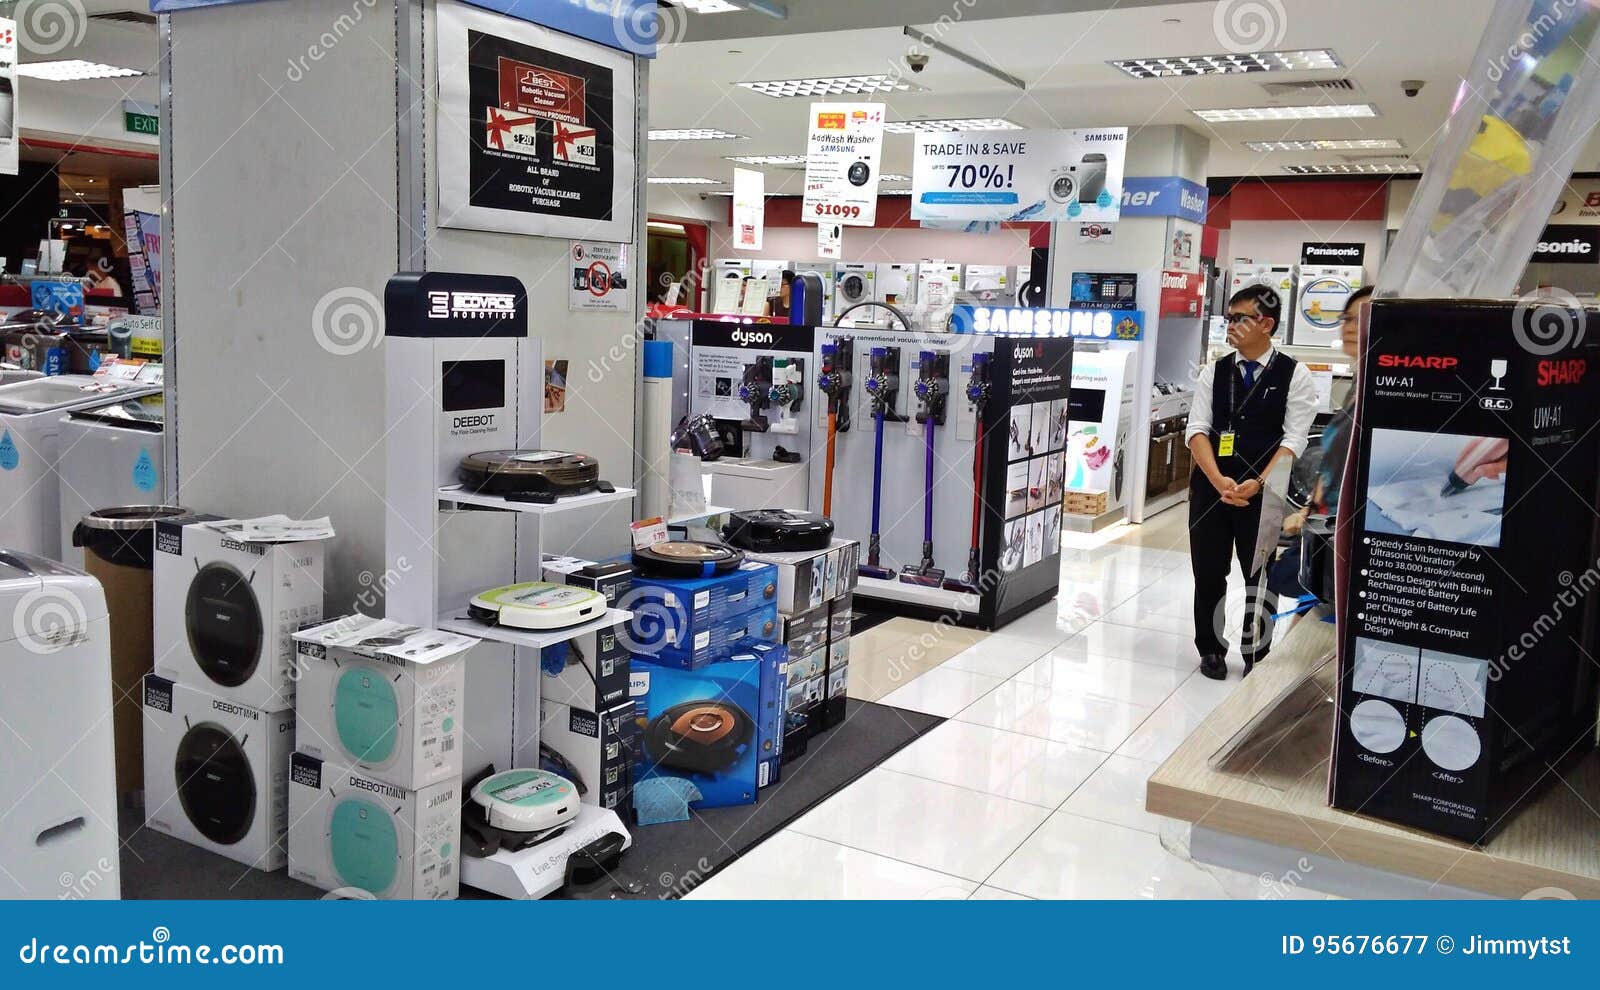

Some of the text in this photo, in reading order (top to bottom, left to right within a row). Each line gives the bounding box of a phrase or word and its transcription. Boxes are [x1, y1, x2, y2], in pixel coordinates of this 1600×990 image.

[532, 76, 554, 88] BEST
[521, 86, 566, 100] Robotic Vacuum
[533, 97, 555, 107] Cleaner
[811, 134, 875, 144] AddWash Washer
[1084, 133, 1124, 142] SAMSUNG
[820, 145, 856, 153] SAMSUNG
[924, 143, 1026, 156] TRADE IN & SAVE
[527, 165, 560, 177] ALL BRAND
[947, 164, 1014, 189] 70%!
[542, 178, 550, 186] OF
[508, 183, 581, 200] ROBOTIC VACUUM CLEANER
[532, 197, 560, 208] PURCHASE
[1180, 186, 1205, 213] Washer
[815, 203, 860, 218] $1099
[1306, 246, 1360, 257] Panasonic
[1534, 239, 1592, 254] sonic
[1162, 272, 1188, 290] Brandt
[453, 294, 514, 309] ECOVACS
[453, 311, 514, 320] ROBOTICS
[973, 307, 1113, 338] SAMSUNG
[731, 328, 773, 346] dyson
[857, 335, 896, 343] conventional
[1013, 343, 1034, 364] dyson
[1378, 354, 1458, 369] SHARP
[1537, 359, 1586, 387] SHARP
[1376, 376, 1414, 388] UW-A1
[1375, 389, 1405, 398] Ultrasonic
[1406, 391, 1430, 399] Washer
[1484, 399, 1509, 409] R.C.
[453, 414, 495, 429] DEEBOT
[1534, 405, 1562, 429] UW-A1
[158, 543, 180, 554] ROBOT
[220, 539, 249, 552] DEEBOT
[1371, 537, 1481, 562] Speedy Stain Removal by
[1370, 547, 1455, 567] Ultrasonic Vibration
[1369, 558, 1485, 582] (Up to 38,000 stroke/second)
[1368, 569, 1493, 596] Cordless Design with Built-in
[1367, 579, 1460, 602] Rechargeable Battery
[1366, 602, 1413, 617] per Charge
[1367, 591, 1477, 617] 30 minutes of Battery Life
[1364, 623, 1394, 636] Design
[1365, 614, 1470, 639] Light Weight & Compact
[147, 698, 169, 711] ROBOT
[213, 700, 243, 715] DEEBOT
[572, 725, 596, 736] ROBOT
[294, 775, 318, 788] ROBOT
[350, 776, 386, 794] DEEBOT
[1412, 792, 1476, 814] SHARP CORPORATION
[1433, 804, 1449, 814] MADE
[1456, 810, 1475, 820] CHINA
